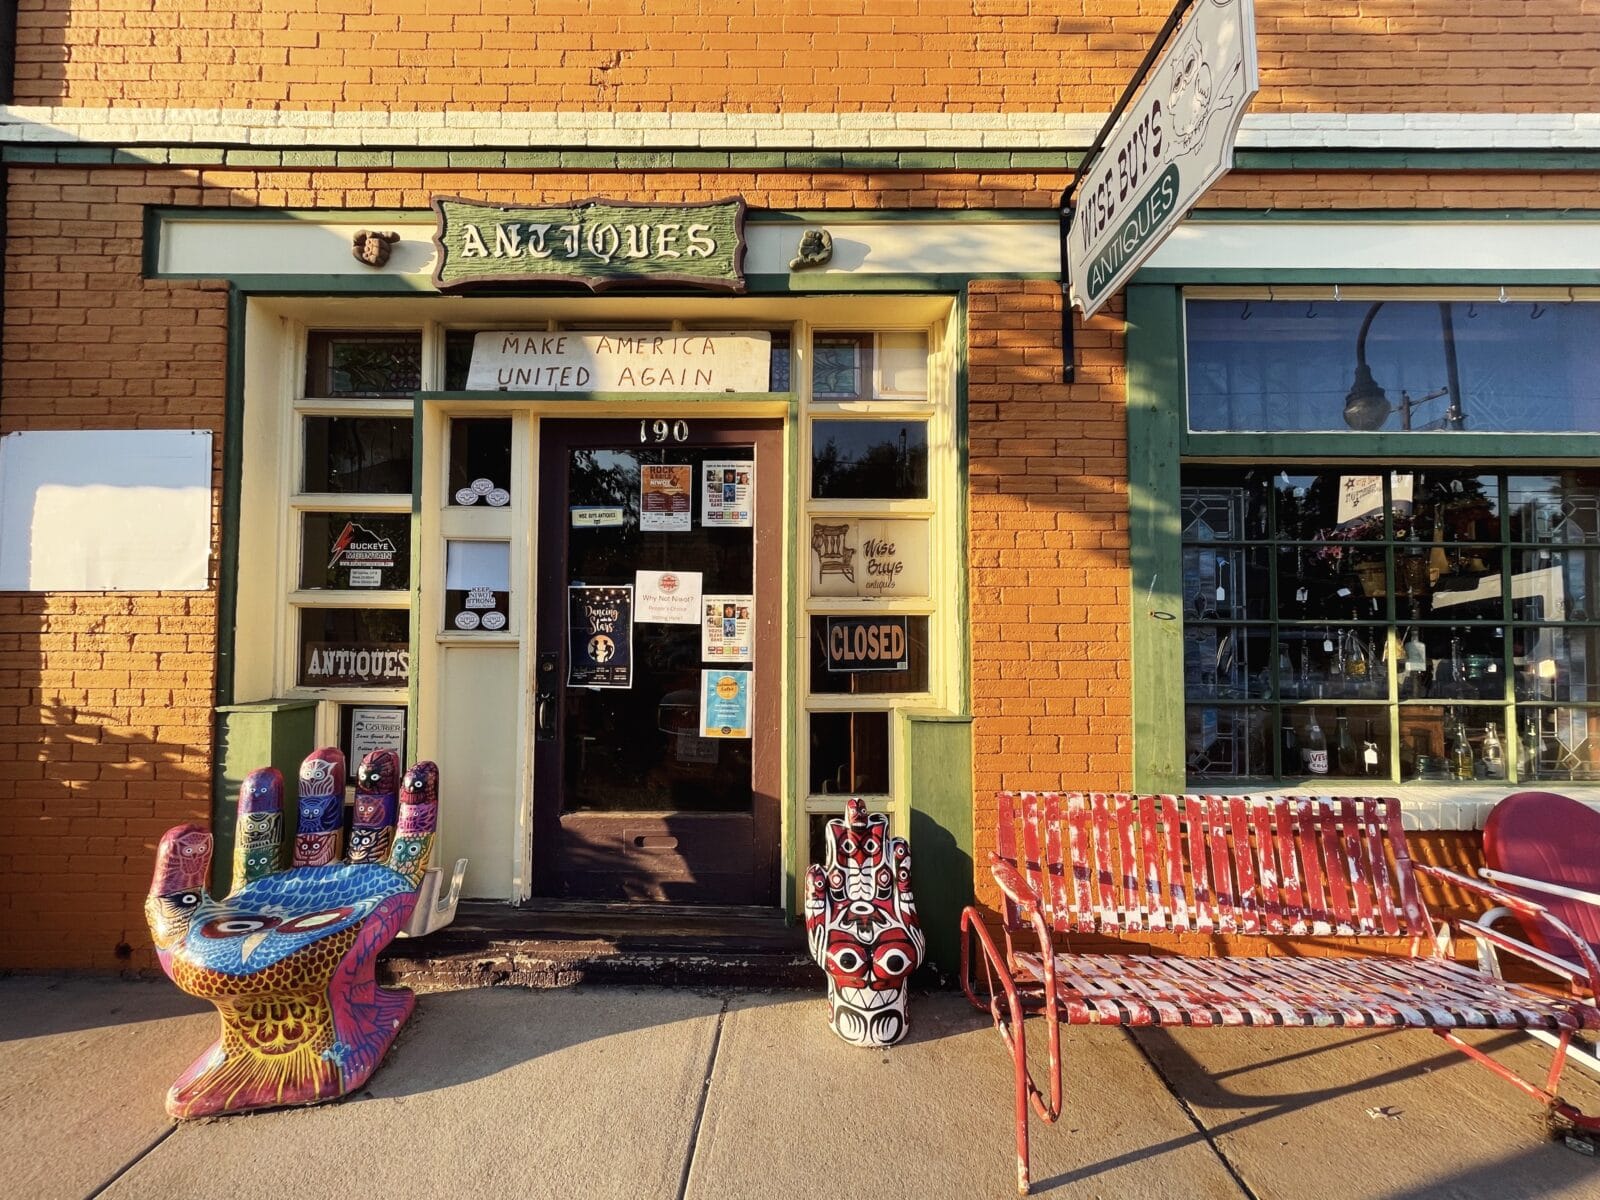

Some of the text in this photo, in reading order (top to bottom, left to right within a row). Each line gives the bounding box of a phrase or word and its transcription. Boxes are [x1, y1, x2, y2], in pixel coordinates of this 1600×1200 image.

[1080, 100, 1163, 252] WISE BUYS
[460, 223, 718, 264] ANTIQUES
[1091, 175, 1174, 294] ANTIQUES
[502, 335, 716, 356] MAKE AMERICA
[497, 366, 713, 387] UNITED AGAIN
[640, 419, 689, 443] 190
[350, 542, 389, 550] BUCKEYE
[863, 538, 896, 557] Wise
[868, 559, 903, 584] Buys
[585, 605, 619, 621] Dancing
[830, 624, 905, 662] CLOSED
[308, 648, 409, 680] ANTIQUES
